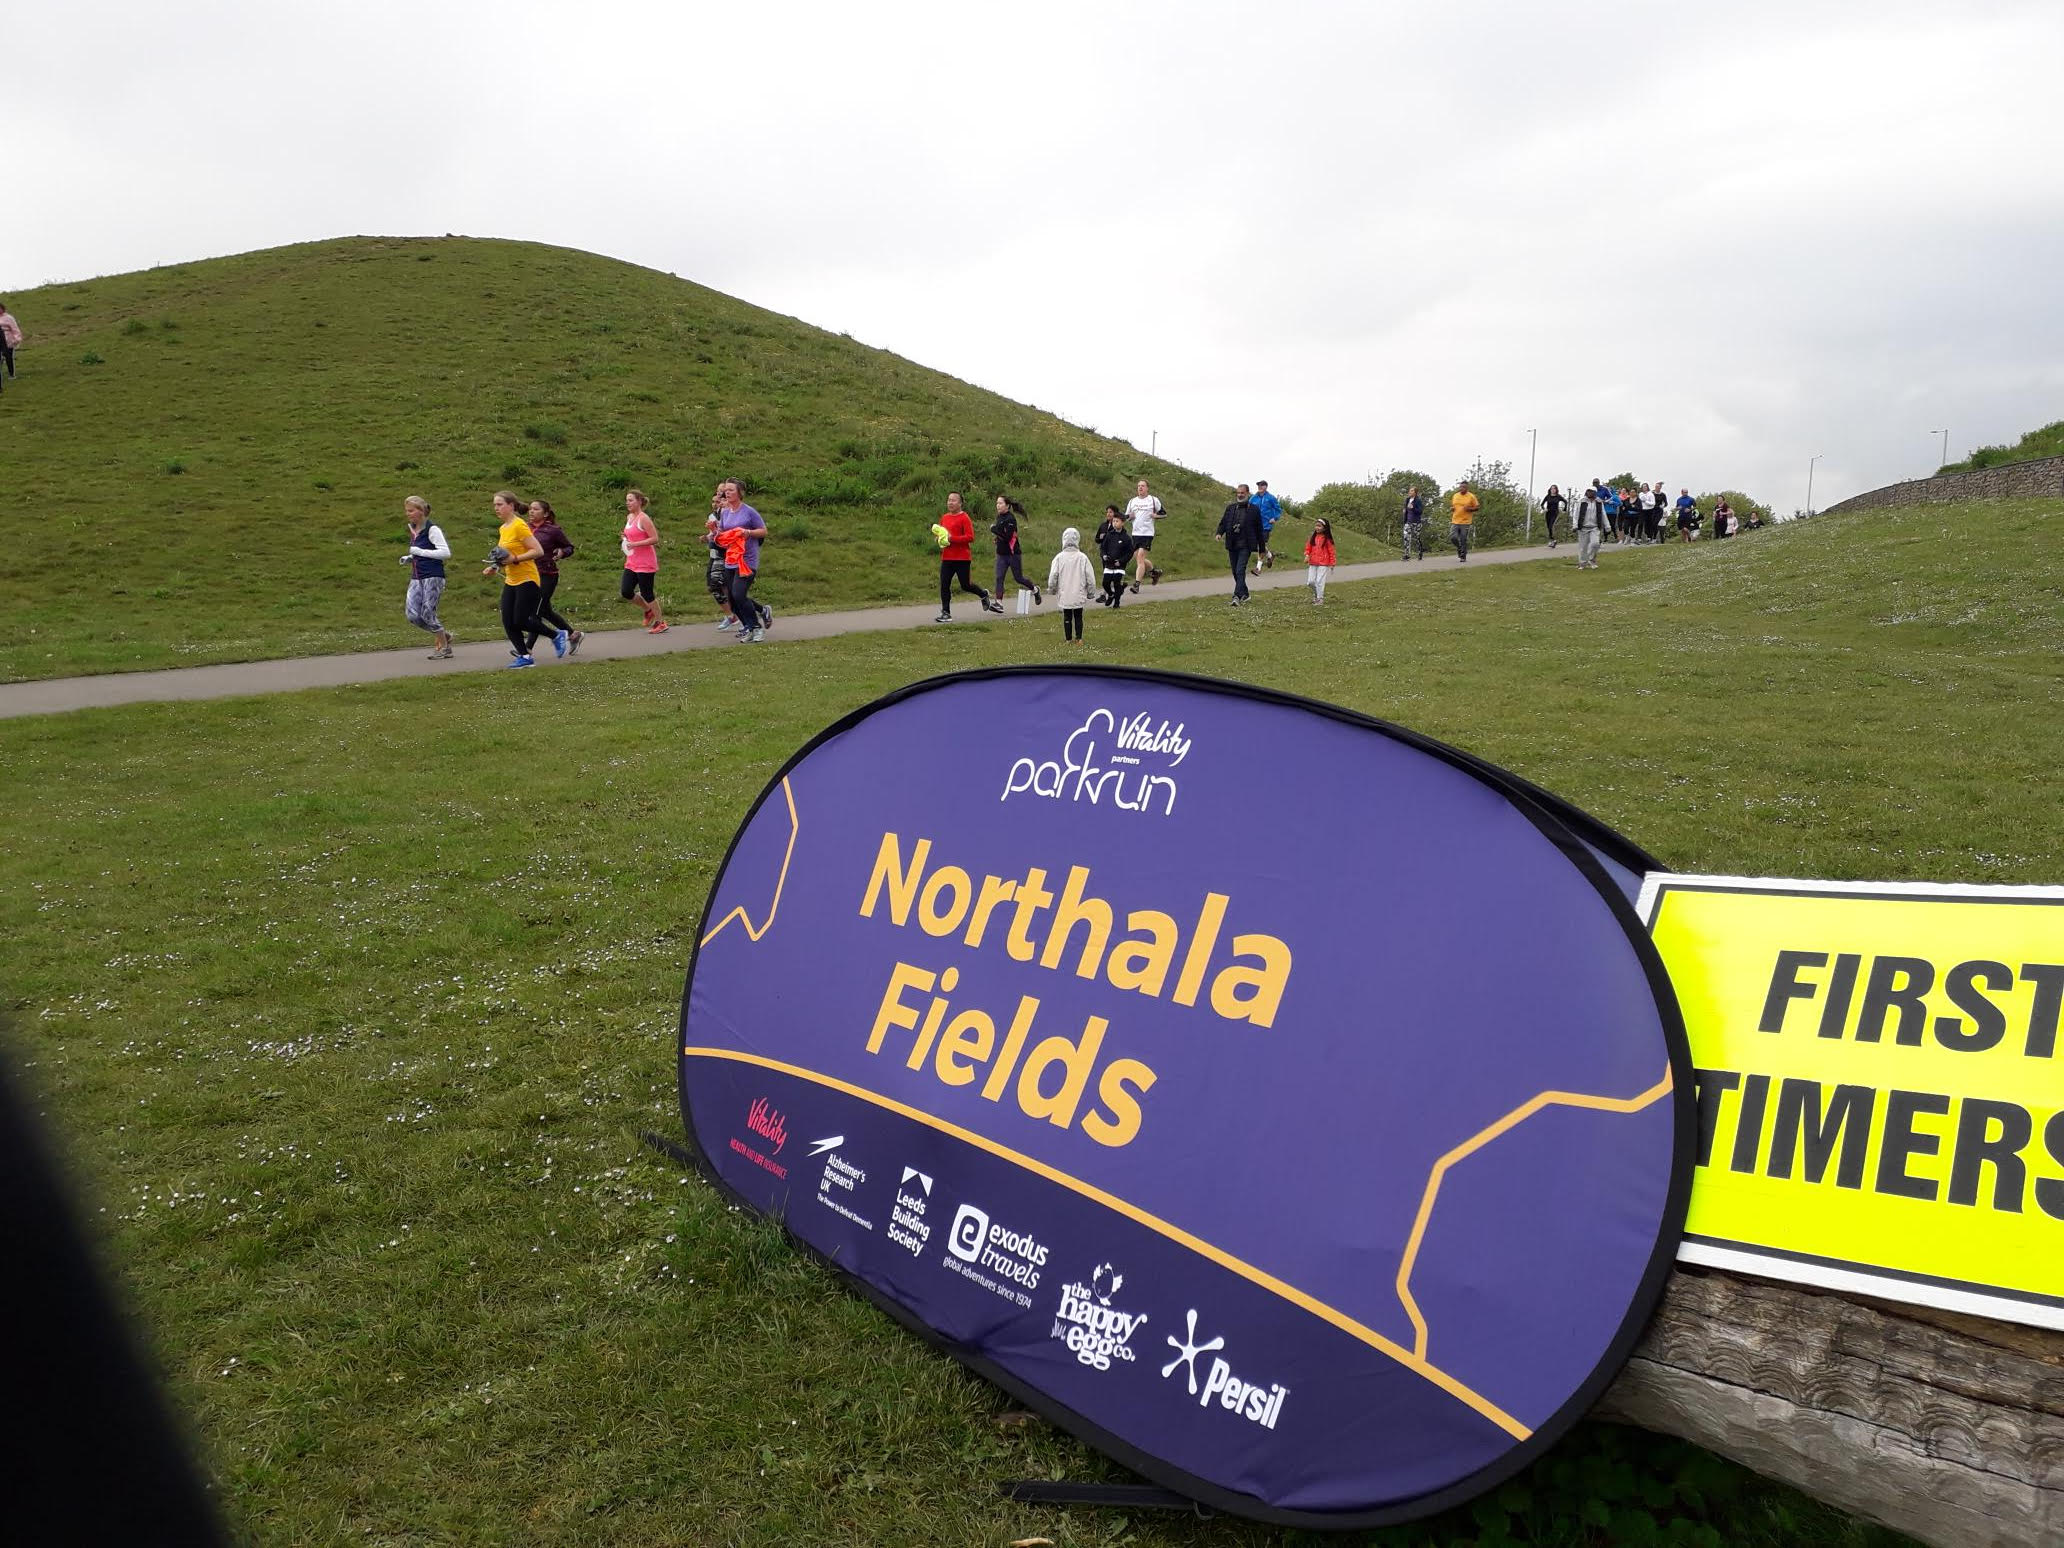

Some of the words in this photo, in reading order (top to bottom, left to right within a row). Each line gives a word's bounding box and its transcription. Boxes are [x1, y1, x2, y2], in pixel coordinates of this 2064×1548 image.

[1111, 755, 1140, 765] partners
[1117, 711, 1191, 767] Vitality
[1001, 739, 1177, 816] parkrun
[859, 832, 1292, 1028] Northala
[1758, 950, 2064, 1058] FIRST
[865, 961, 1158, 1147] Fields
[747, 1097, 787, 1155] Vitality
[820, 1178, 831, 1192] UK
[824, 1165, 854, 1191] Research
[827, 1153, 866, 1183] Alzheimer's
[891, 1205, 931, 1242] Building
[896, 1187, 926, 1215] Leeds
[887, 1222, 924, 1257] Society
[989, 1224, 1049, 1266] exodus
[942, 1256, 963, 1273] global
[961, 1266, 997, 1292] adventures
[996, 1284, 1015, 1301] since
[1015, 1291, 1032, 1310] 1974
[980, 1243, 1040, 1289] travels
[1071, 1281, 1092, 1300] the
[1056, 1284, 1148, 1344] happy
[1066, 1326, 1115, 1371] egg
[1200, 1357, 1286, 1430] Persil
